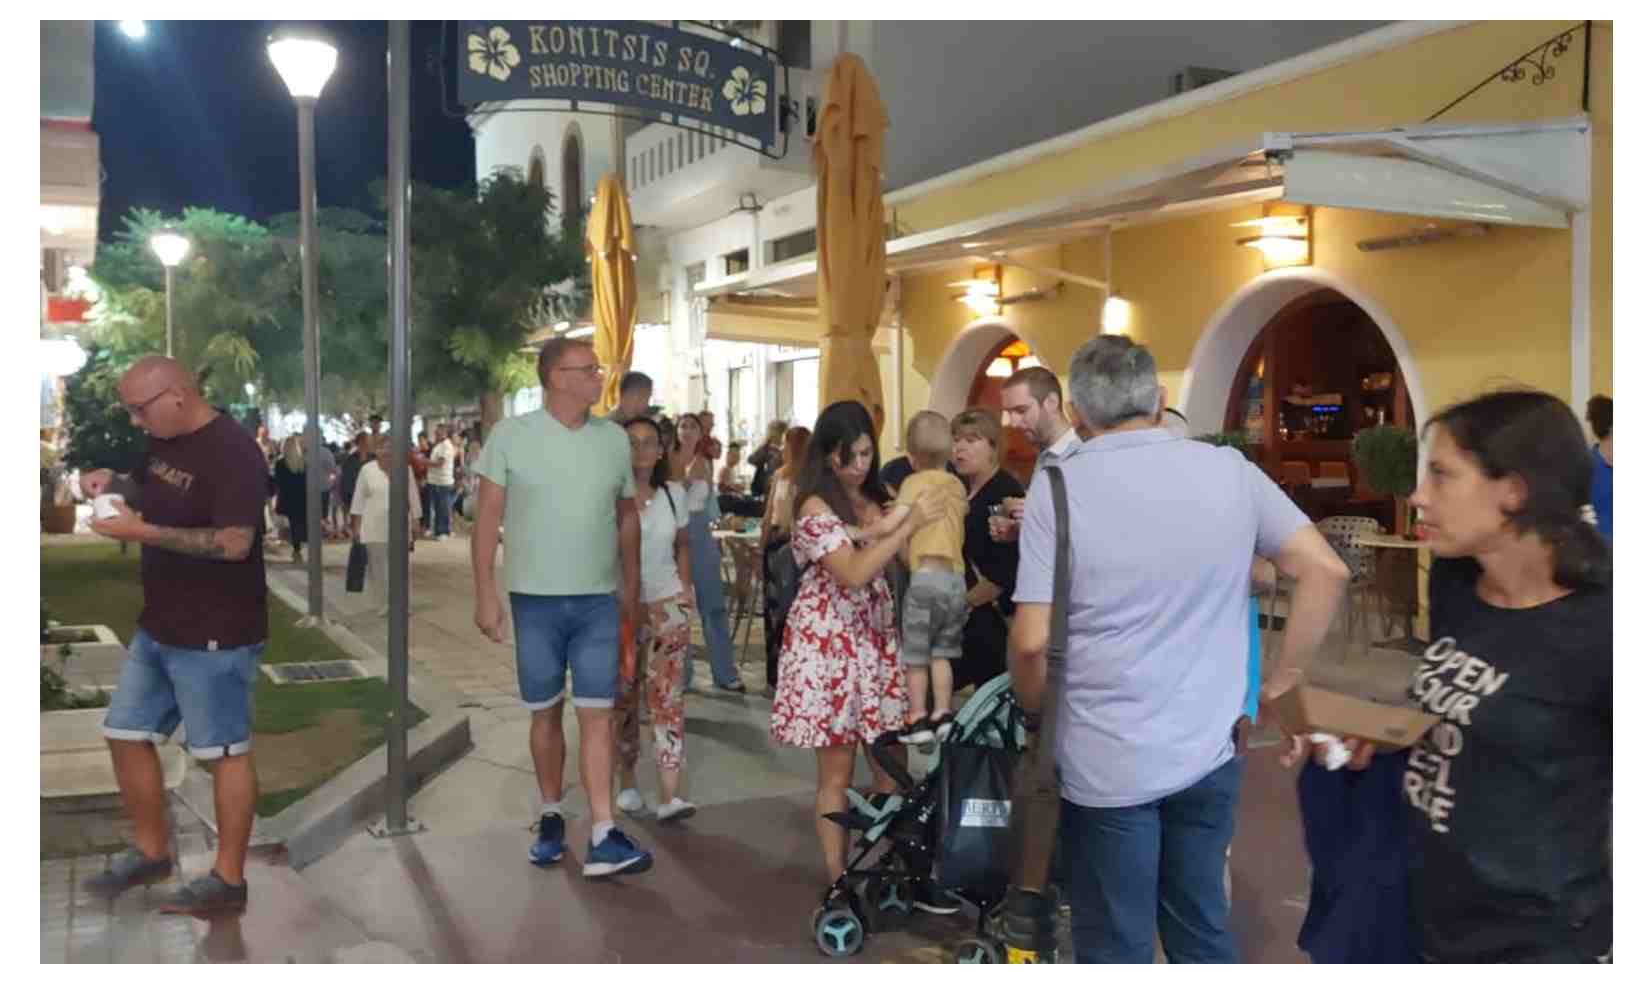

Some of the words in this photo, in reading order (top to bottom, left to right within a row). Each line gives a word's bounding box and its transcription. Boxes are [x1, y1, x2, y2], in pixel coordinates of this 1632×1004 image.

[528, 25, 669, 68] KONITSIS
[677, 46, 716, 79] SQ.
[528, 63, 630, 94] SHOPPING
[635, 74, 714, 112] CENTER
[1412, 663, 1481, 726] YOUR
[1423, 636, 1510, 696] OPEN
